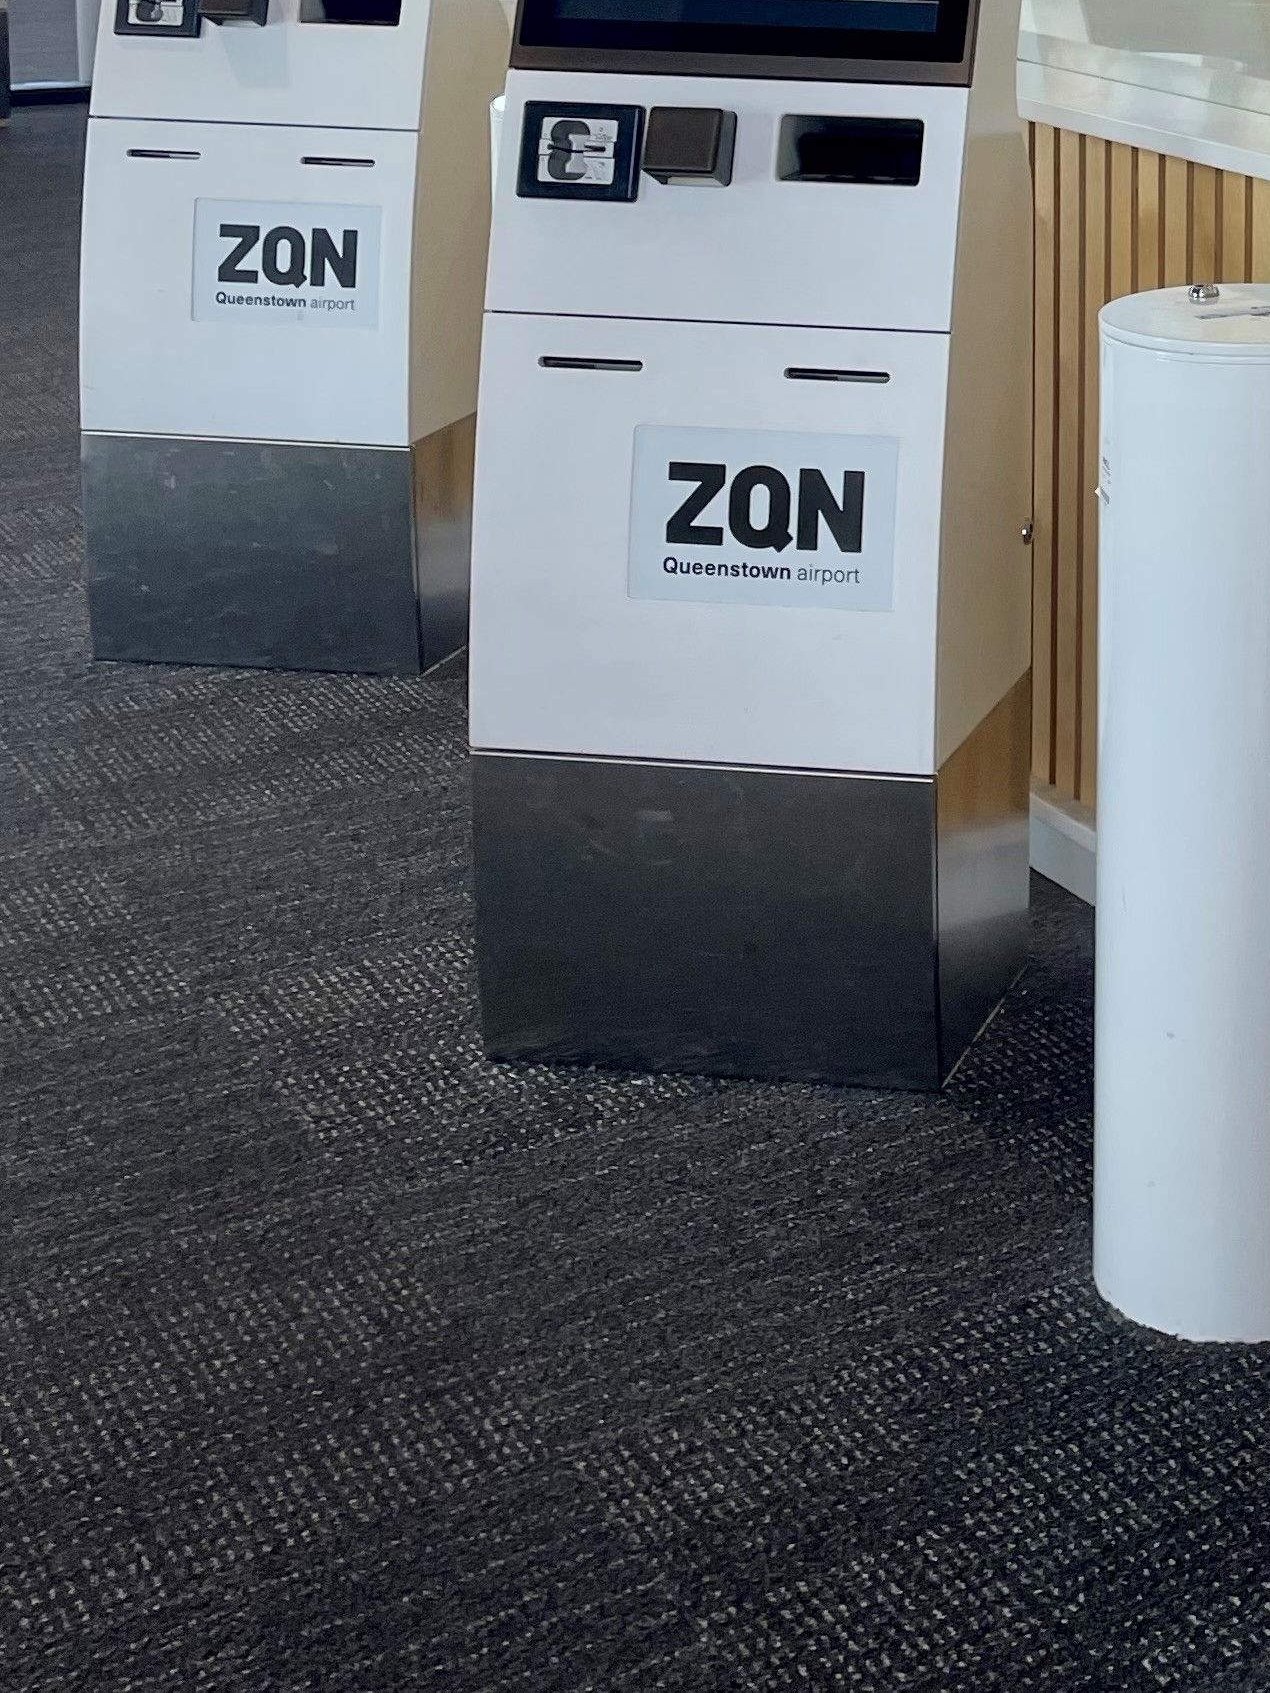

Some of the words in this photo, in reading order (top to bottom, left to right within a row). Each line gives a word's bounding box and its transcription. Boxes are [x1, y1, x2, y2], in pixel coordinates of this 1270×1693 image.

[218, 223, 358, 288] ZQN
[215, 291, 307, 308] Queenstown
[310, 296, 355, 311] airport
[666, 461, 865, 553] ZQN
[663, 556, 791, 580] Queenstown
[797, 564, 860, 586] airport
